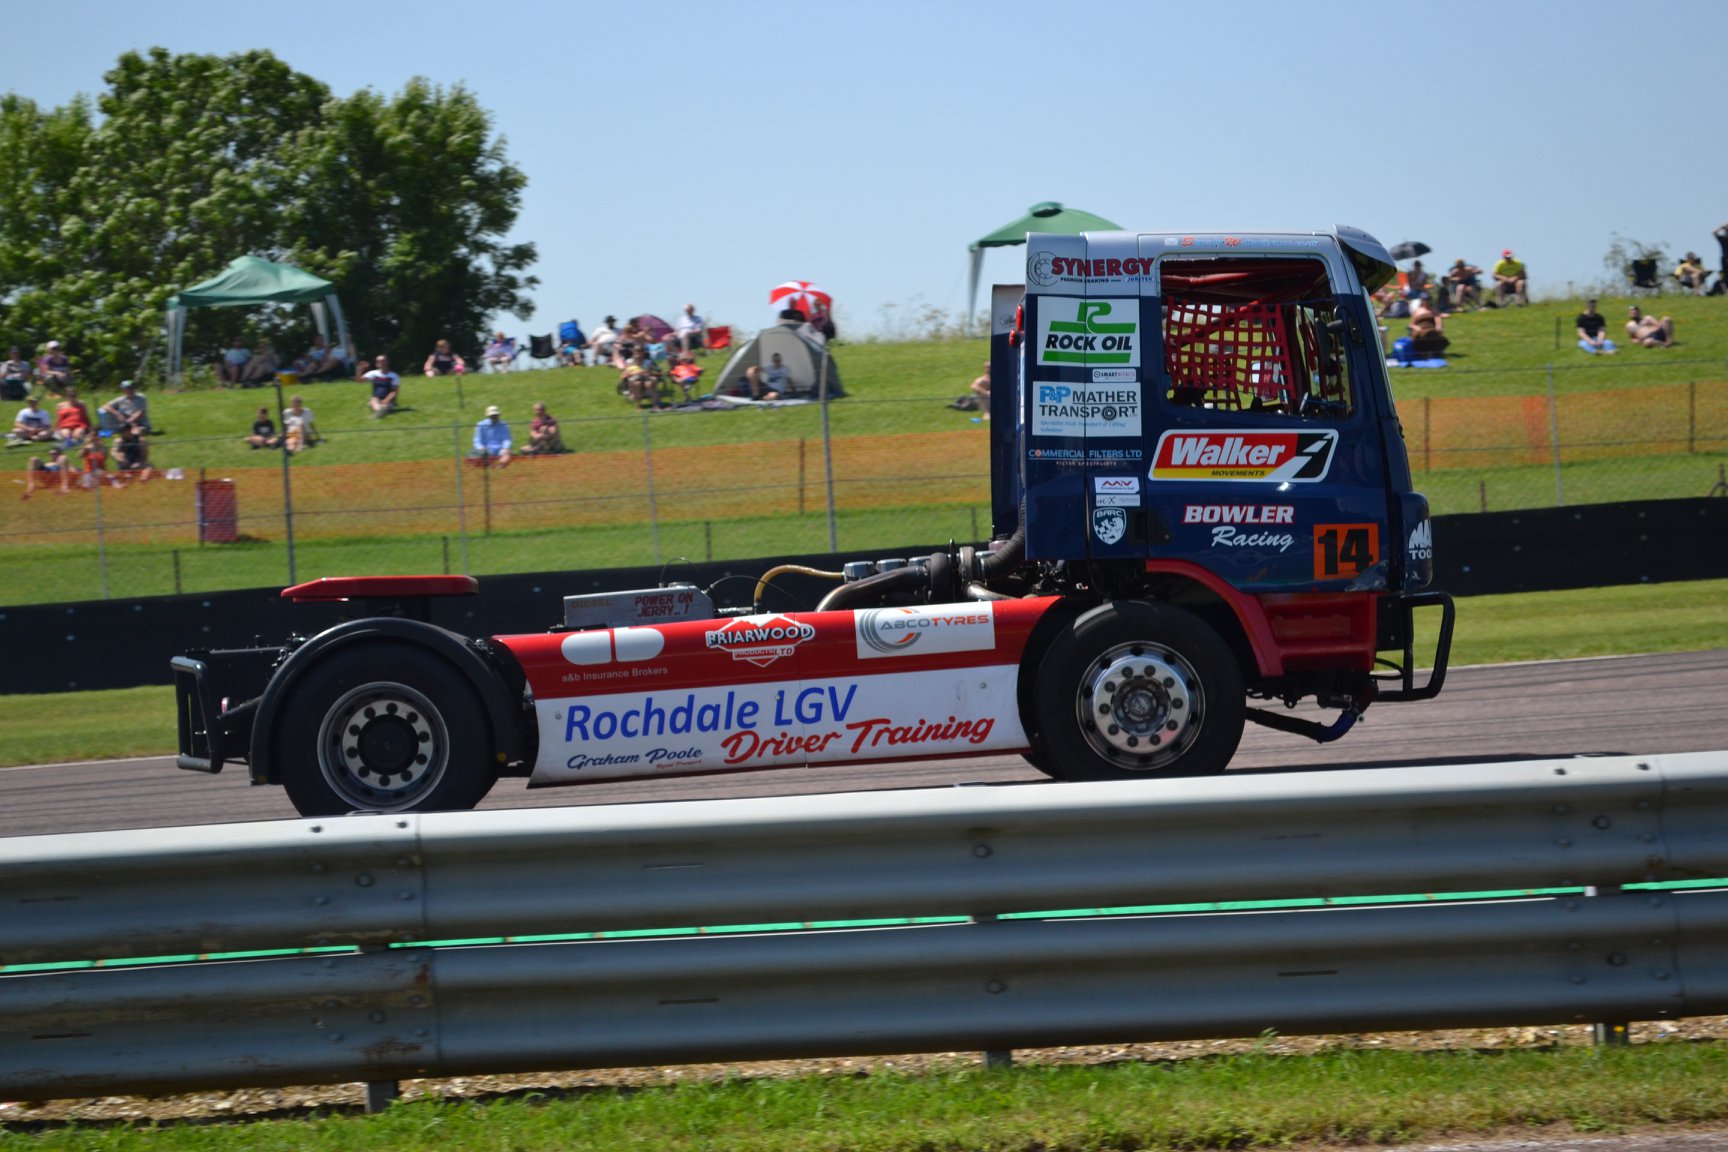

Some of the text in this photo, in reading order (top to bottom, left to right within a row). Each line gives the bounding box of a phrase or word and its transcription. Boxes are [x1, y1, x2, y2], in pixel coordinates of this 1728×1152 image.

[1051, 257, 1155, 277] SYNERGY
[1046, 334, 1132, 350] ROCK OIL
[1039, 385, 1137, 403] P&P MATHER
[1039, 405, 1138, 420] TRANSPORT
[1028, 449, 1142, 458] COMMERCIAL FILTERS LTD
[1170, 437, 1286, 466] Walker
[1096, 510, 1123, 518] BARC
[1182, 504, 1295, 524] BOWLER
[1211, 526, 1294, 553] Racing
[1317, 528, 1374, 576] 14
[635, 592, 694, 608] POWER ON
[880, 614, 989, 630] ABCOTYRES
[708, 625, 813, 645] BRIARWOOD
[562, 667, 668, 682] a&b Insurance Brokers
[564, 684, 858, 742] Rochdale LGV
[721, 715, 996, 764] Driver Training
[567, 747, 703, 770] Graham Poole
